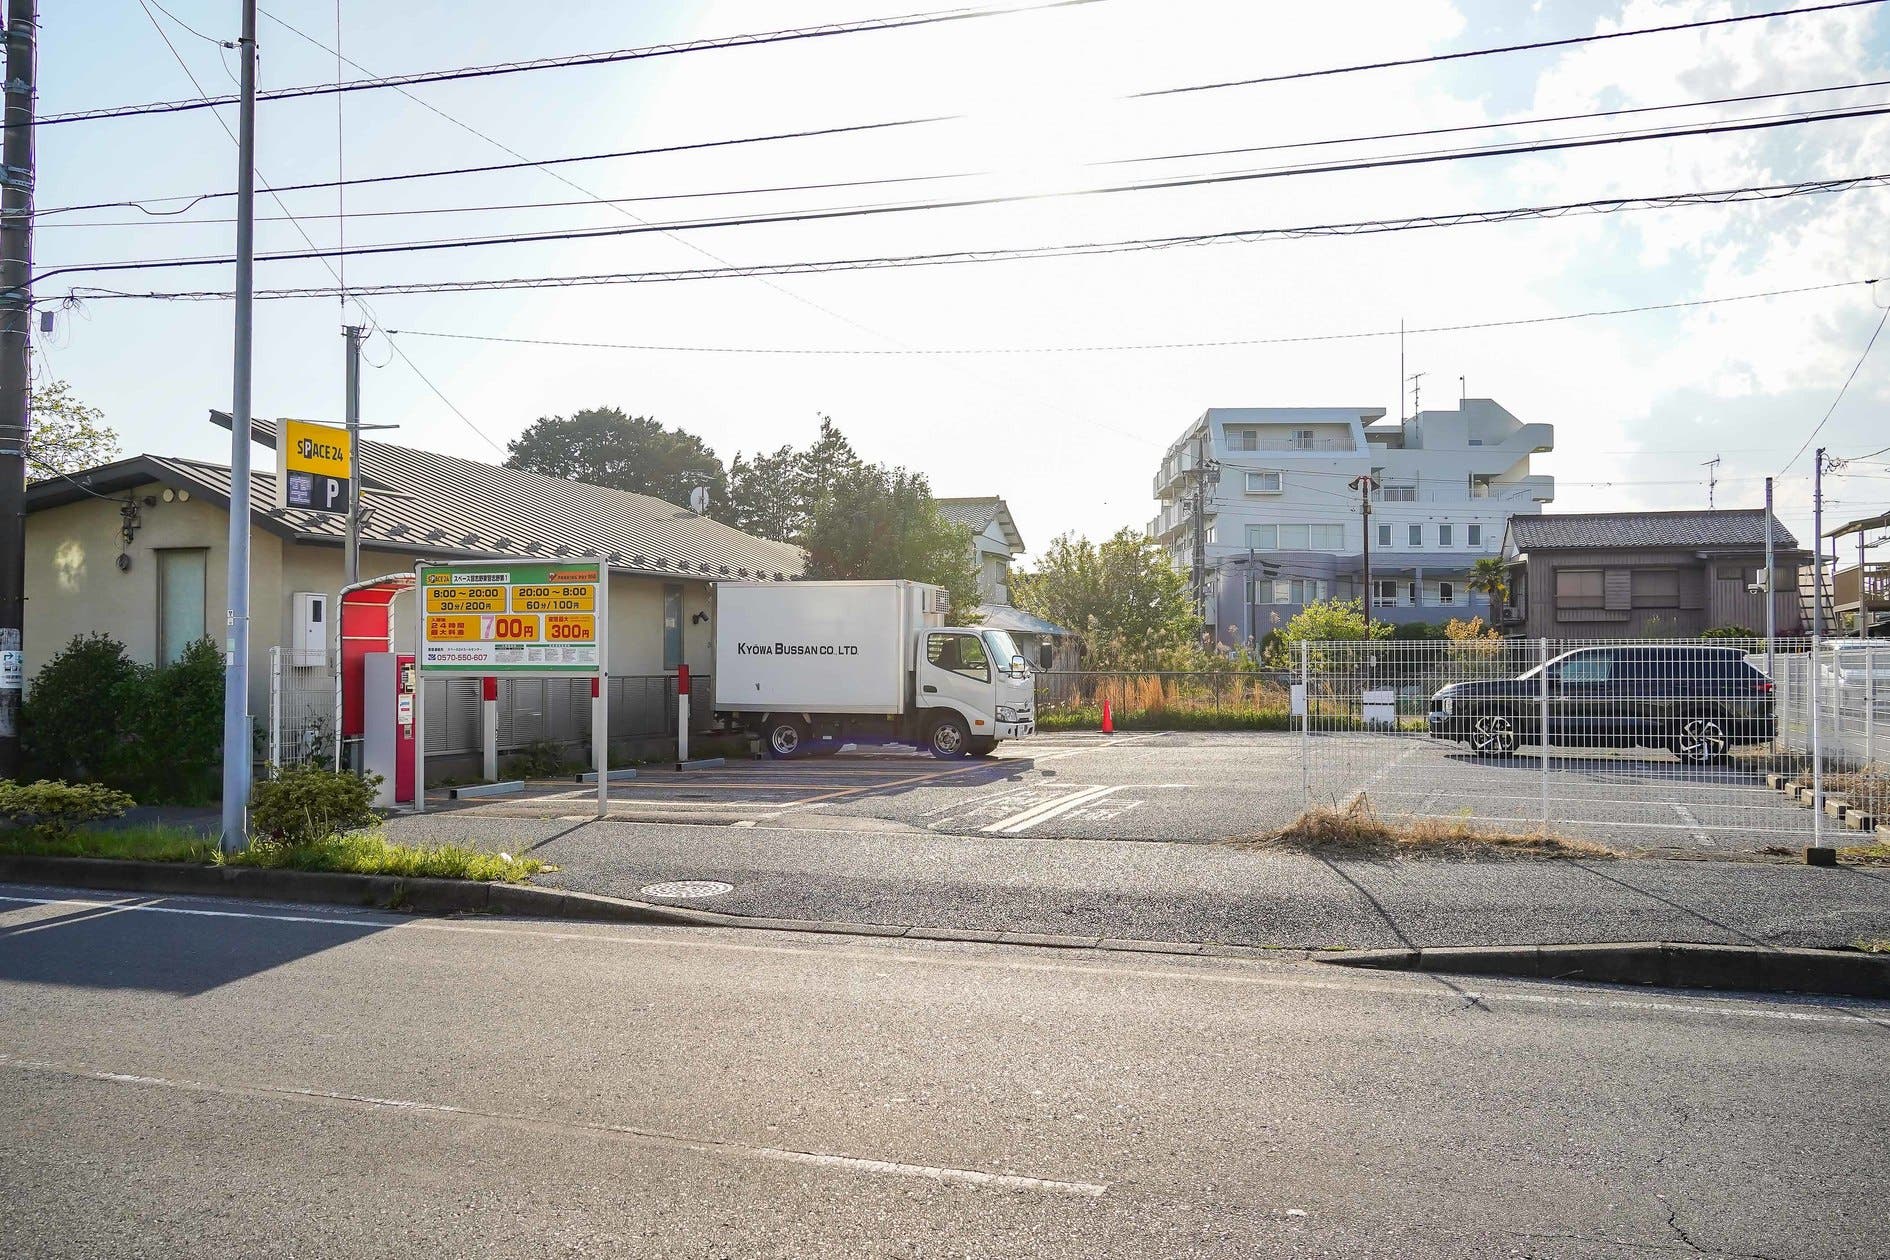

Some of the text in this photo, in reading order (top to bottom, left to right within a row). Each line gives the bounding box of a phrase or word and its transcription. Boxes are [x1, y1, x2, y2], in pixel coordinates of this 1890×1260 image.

[326, 478, 339, 508] P
[434, 589, 456, 598] 8:00
[469, 589, 498, 598] 20:00
[519, 588, 549, 597] 20:00
[562, 587, 586, 596] 8:00
[551, 624, 590, 639] 300円
[774, 642, 818, 655] BUSSAN
